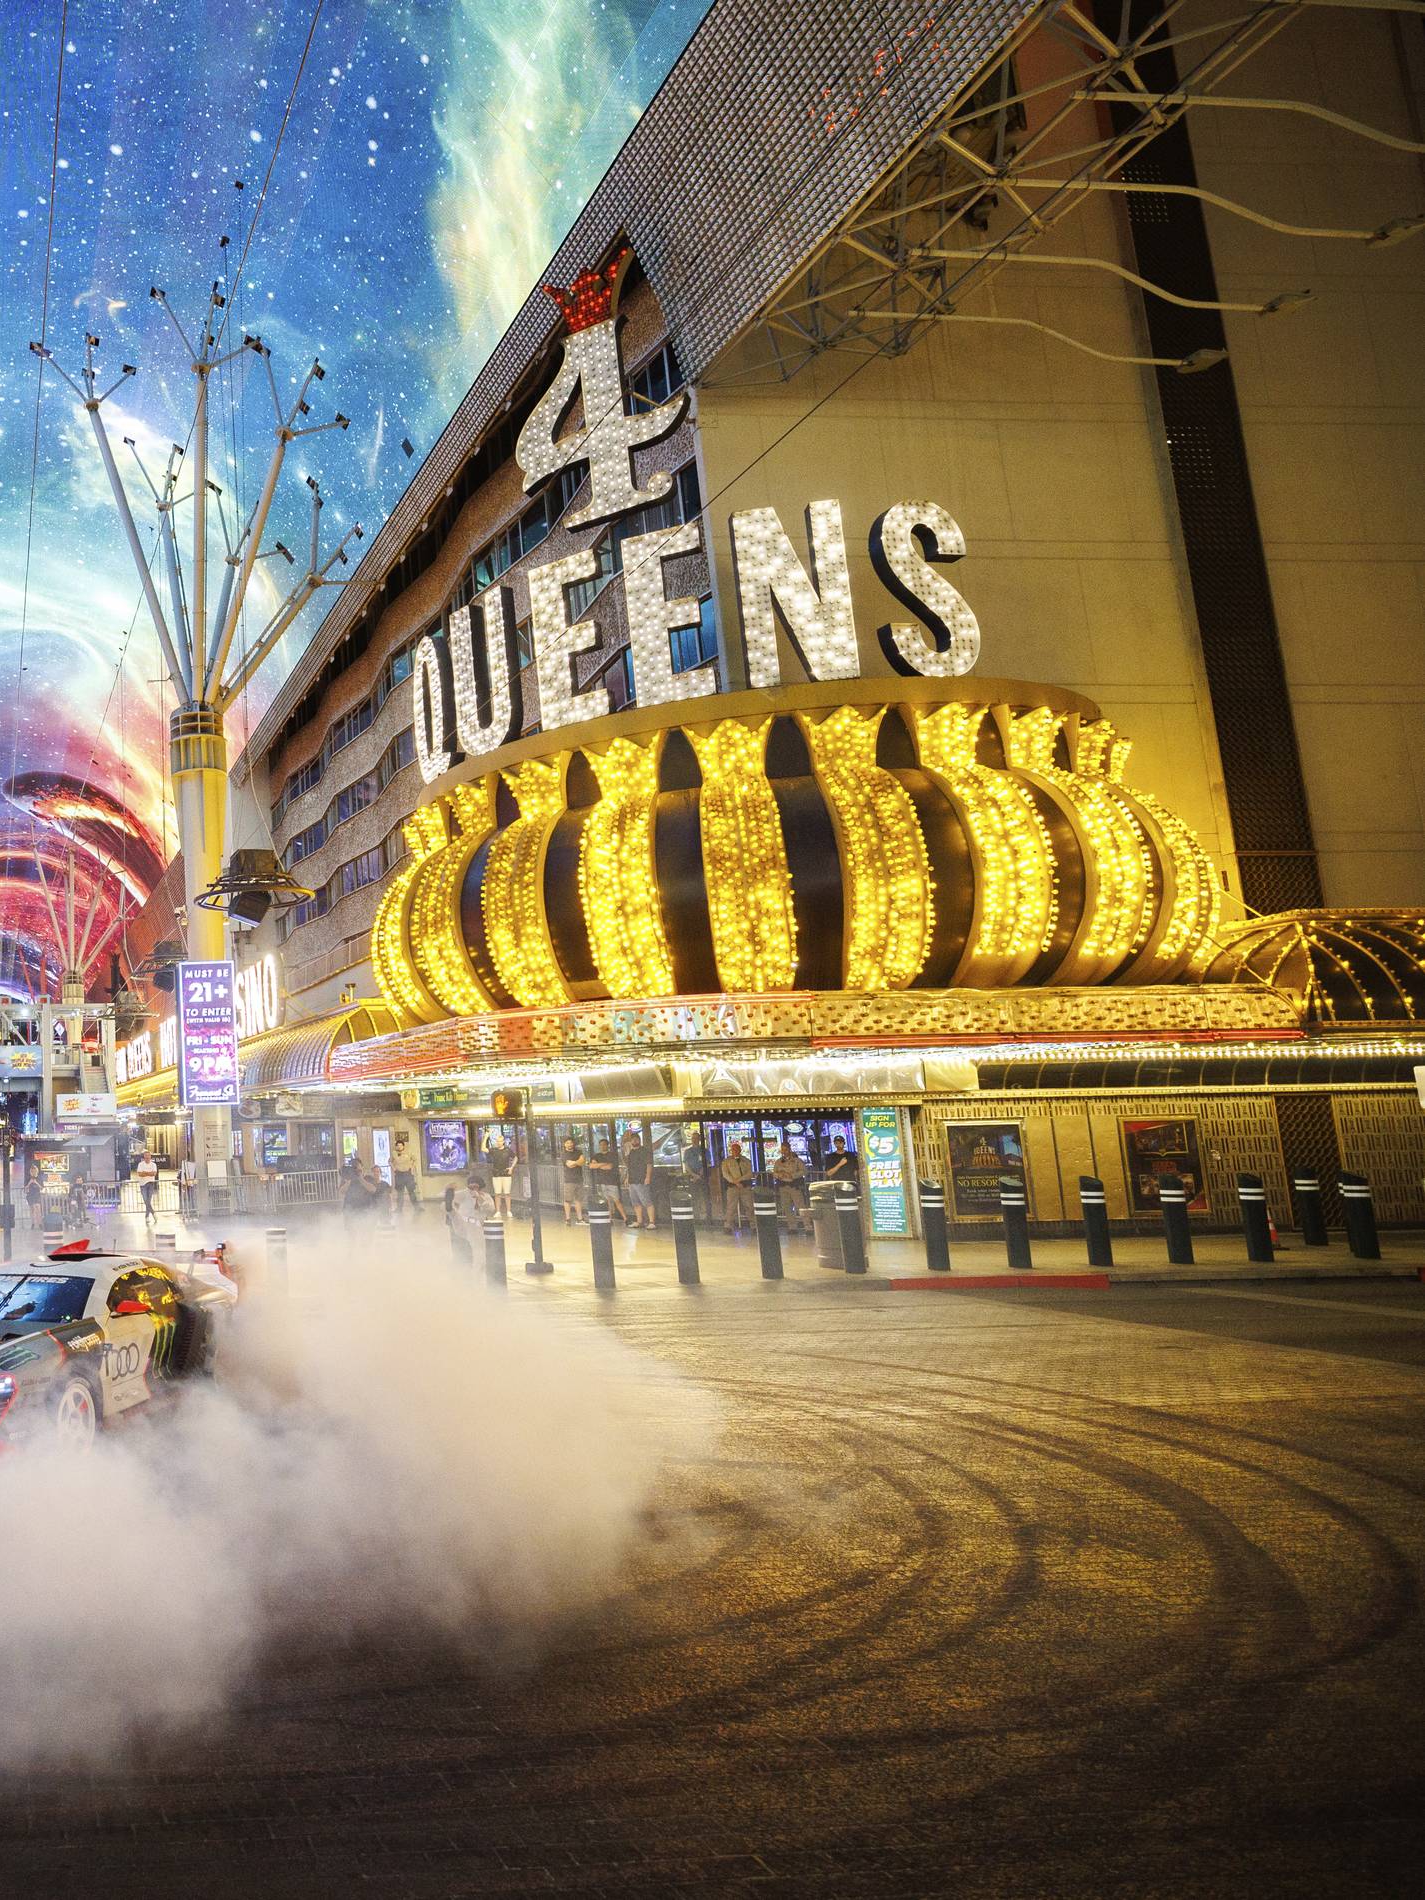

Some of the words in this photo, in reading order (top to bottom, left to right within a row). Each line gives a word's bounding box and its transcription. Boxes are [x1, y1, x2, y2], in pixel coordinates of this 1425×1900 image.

[516, 318, 687, 529] 4
[413, 499, 980, 784] QUEENS
[185, 969, 213, 978] MUST
[216, 968, 229, 978] BE
[188, 982, 229, 1003] 21+
[185, 1008, 199, 1017] TO
[202, 1007, 232, 1016] ENTER
[186, 1035, 203, 1046] FRI
[210, 1035, 234, 1046] SUN
[869, 1135, 895, 1155] $5
[869, 1160, 901, 1170] FREE
[869, 1169, 902, 1180] SLOT
[869, 1179, 903, 1189] PLAY
[957, 1179, 970, 1187] NO
[971, 1179, 1001, 1187] RESOR
